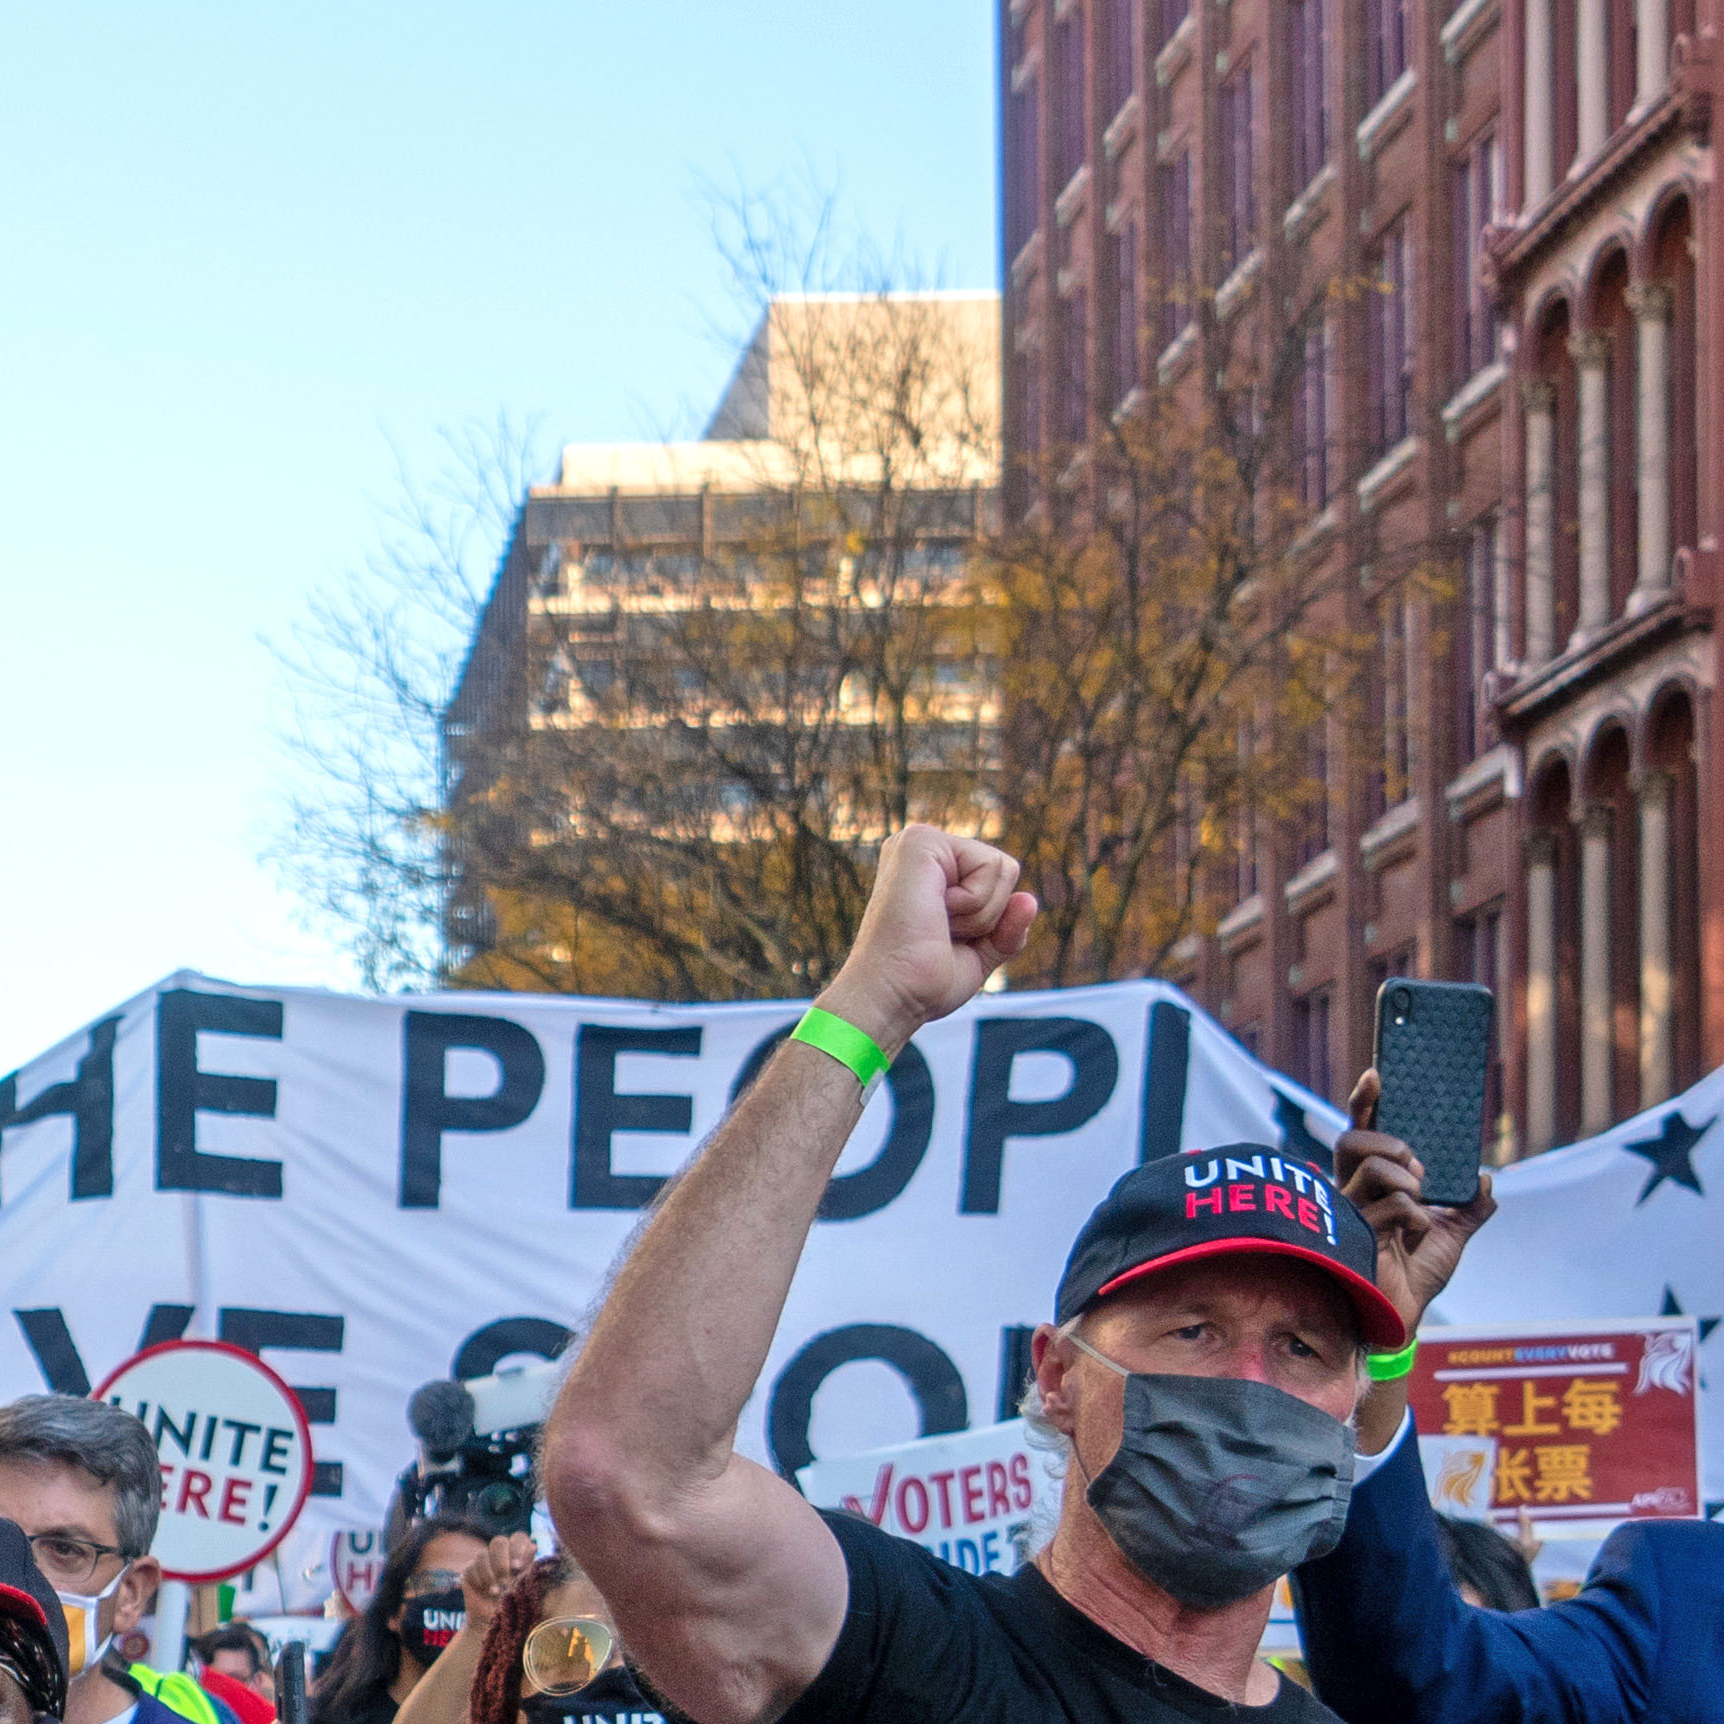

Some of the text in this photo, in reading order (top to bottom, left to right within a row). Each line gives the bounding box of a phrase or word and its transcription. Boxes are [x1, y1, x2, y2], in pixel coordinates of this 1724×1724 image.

[1185, 1156, 1334, 1216] UNITE
[1185, 1183, 1337, 1246] HERE!
[841, 1452, 1032, 1537] VOTERS
